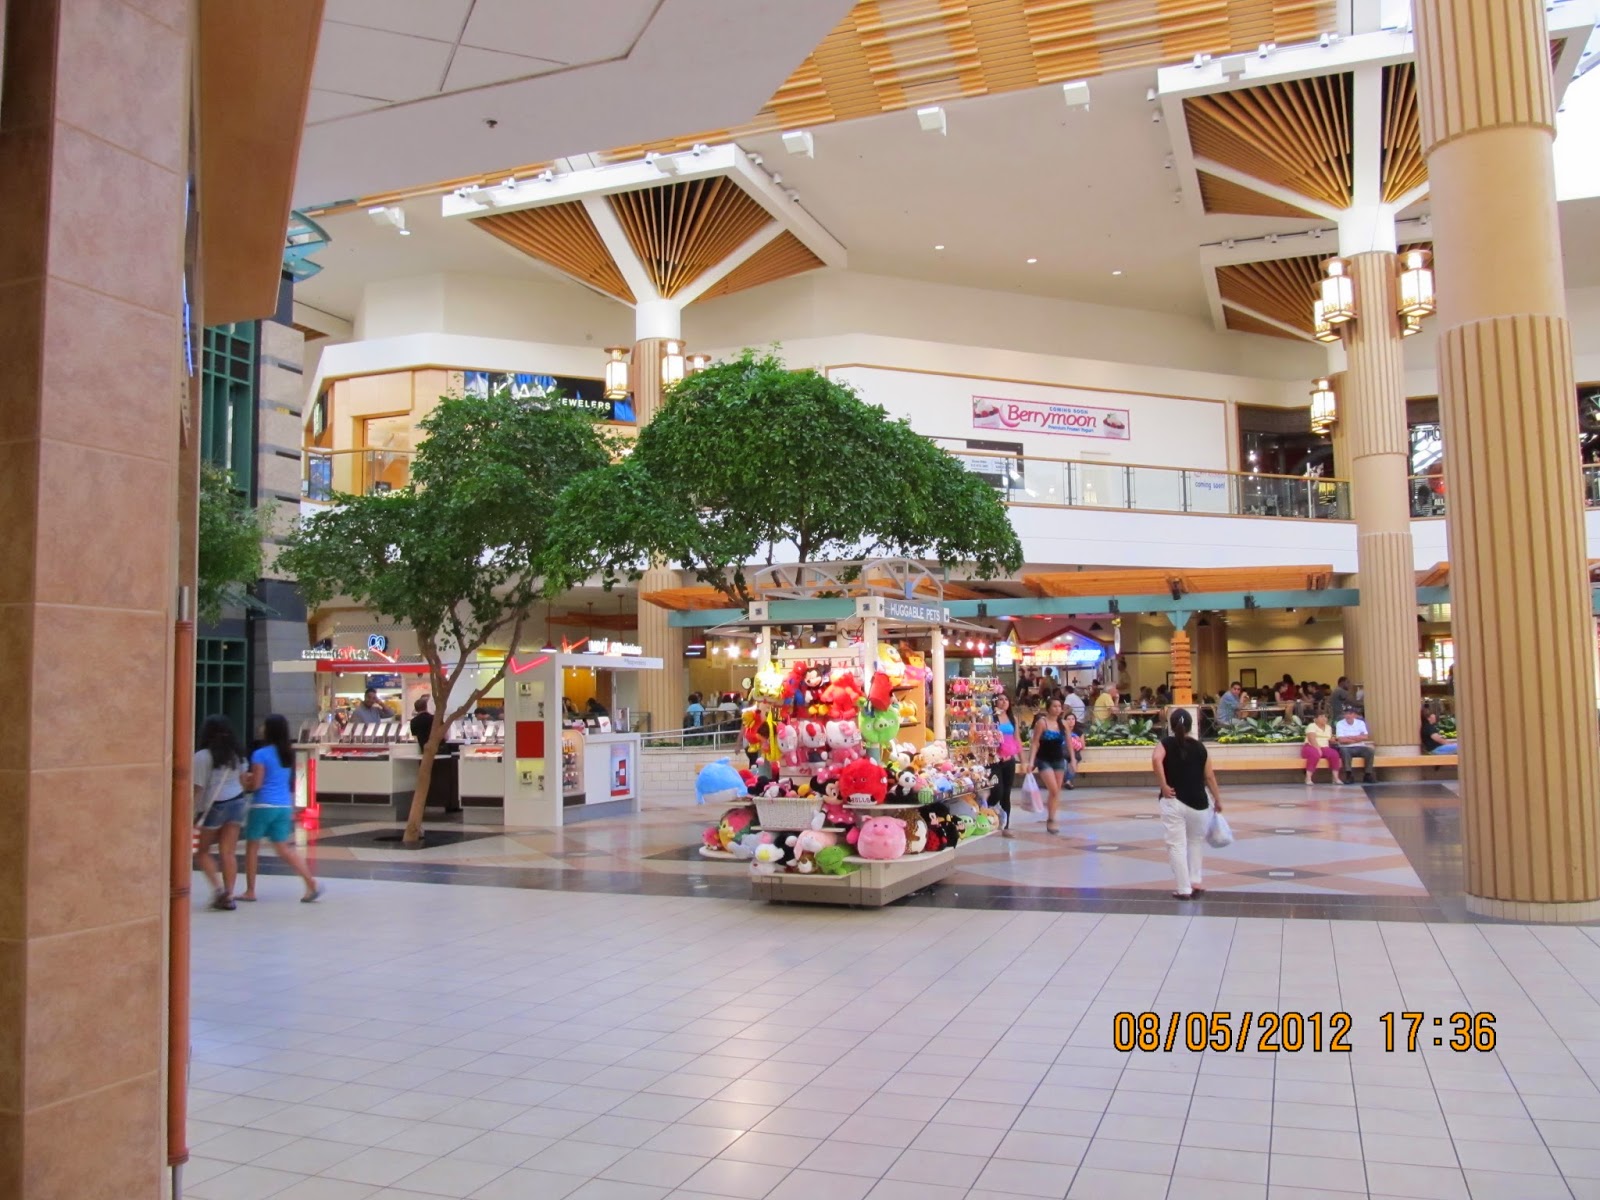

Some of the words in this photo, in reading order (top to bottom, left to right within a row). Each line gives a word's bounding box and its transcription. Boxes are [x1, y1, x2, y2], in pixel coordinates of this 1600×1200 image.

[1008, 404, 1097, 428] Berrymoon
[890, 603, 924, 619] HUGGABLE
[926, 608, 941, 621] PETS
